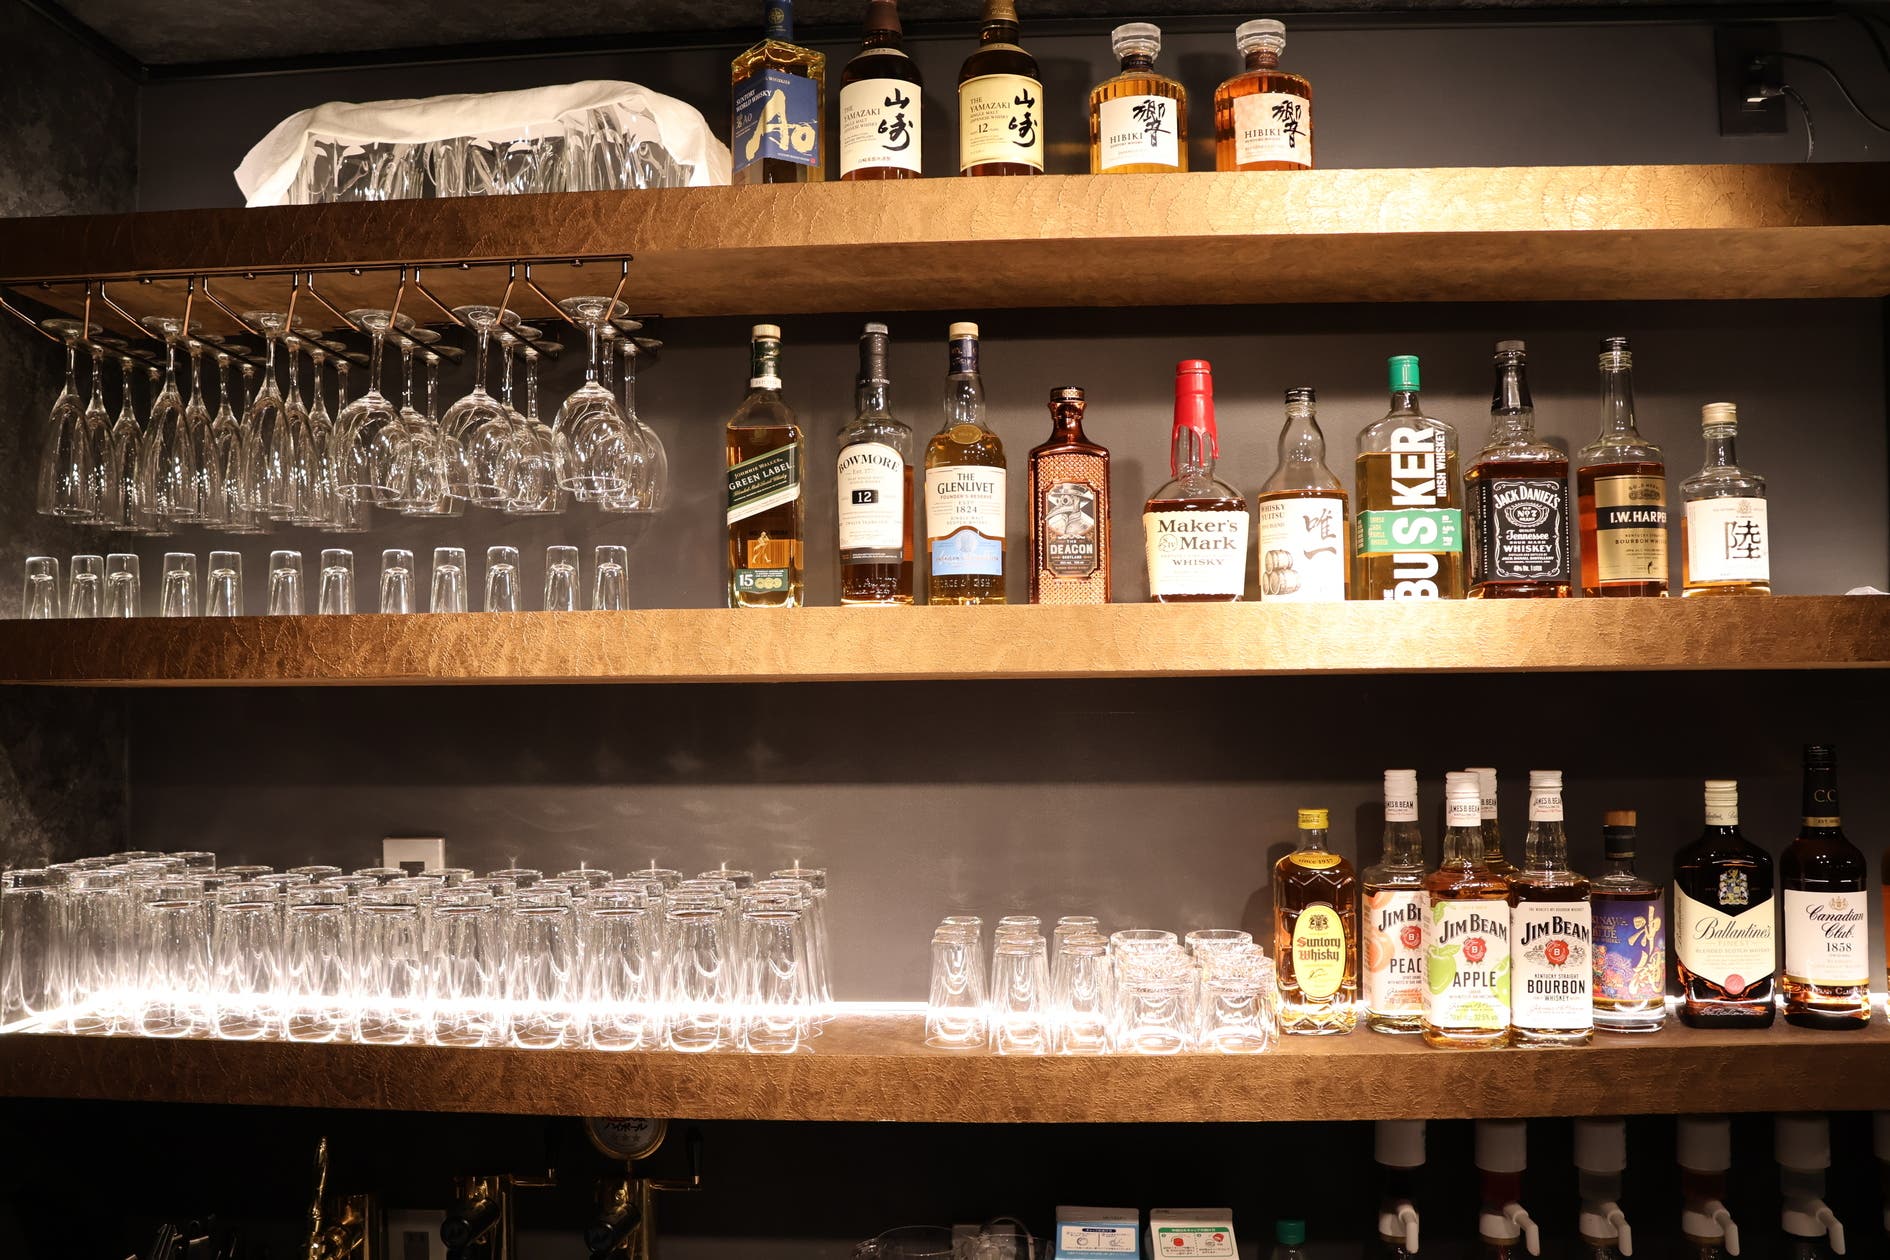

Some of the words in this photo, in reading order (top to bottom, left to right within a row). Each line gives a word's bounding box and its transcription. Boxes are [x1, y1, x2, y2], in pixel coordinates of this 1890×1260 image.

[735, 97, 753, 112] WORLD
[752, 89, 772, 104] WHISKY
[970, 96, 983, 105] THE
[970, 102, 1011, 113] YAMAZAKI
[844, 108, 881, 122] YAMAZAKI
[878, 87, 914, 152] 山崎
[1008, 87, 1038, 148] 山崎
[745, 88, 816, 160] Ao
[978, 122, 989, 134] 12
[1110, 132, 1143, 144] HIBIKI
[1244, 128, 1280, 139] HIBIKI
[1435, 429, 1446, 471] WHISKEY
[838, 454, 900, 474] BOWMORE
[729, 473, 760, 491] GREEN
[763, 461, 793, 479] LABEL
[734, 466, 758, 479] JOHNNIE
[957, 472, 976, 481] THE
[937, 481, 995, 495] GLENLIVET
[1436, 472, 1447, 498] IRISH
[857, 491, 872, 503] 12
[1493, 489, 1520, 509] JACK
[1519, 485, 1561, 511] DANIEL'S
[956, 505, 977, 514] 1824
[1158, 519, 1238, 533] Maker's
[1302, 508, 1337, 560] 唯一
[1506, 529, 1549, 541] Tennessee
[1724, 520, 1762, 560] 陸
[1050, 543, 1093, 555] DEACON
[1180, 536, 1237, 550] Mark
[1503, 545, 1553, 553] WHISKEY
[739, 574, 754, 587] 15
[1805, 903, 1864, 922] Canadian
[1378, 908, 1404, 932] JIM
[1439, 919, 1467, 944] JIM
[1469, 913, 1507, 945] BEAM
[1520, 921, 1550, 946] JIM
[1552, 915, 1590, 946] BEAM
[1692, 916, 1772, 941] Ballantine's
[1297, 936, 1341, 950] Suntory
[1627, 904, 1662, 996] 沖縄
[1826, 942, 1852, 953] 1858
[1298, 948, 1340, 962] Whisky
[1390, 957, 1422, 974] PEAC
[1452, 971, 1497, 988] APPLE
[1527, 979, 1586, 994] BOURBON
